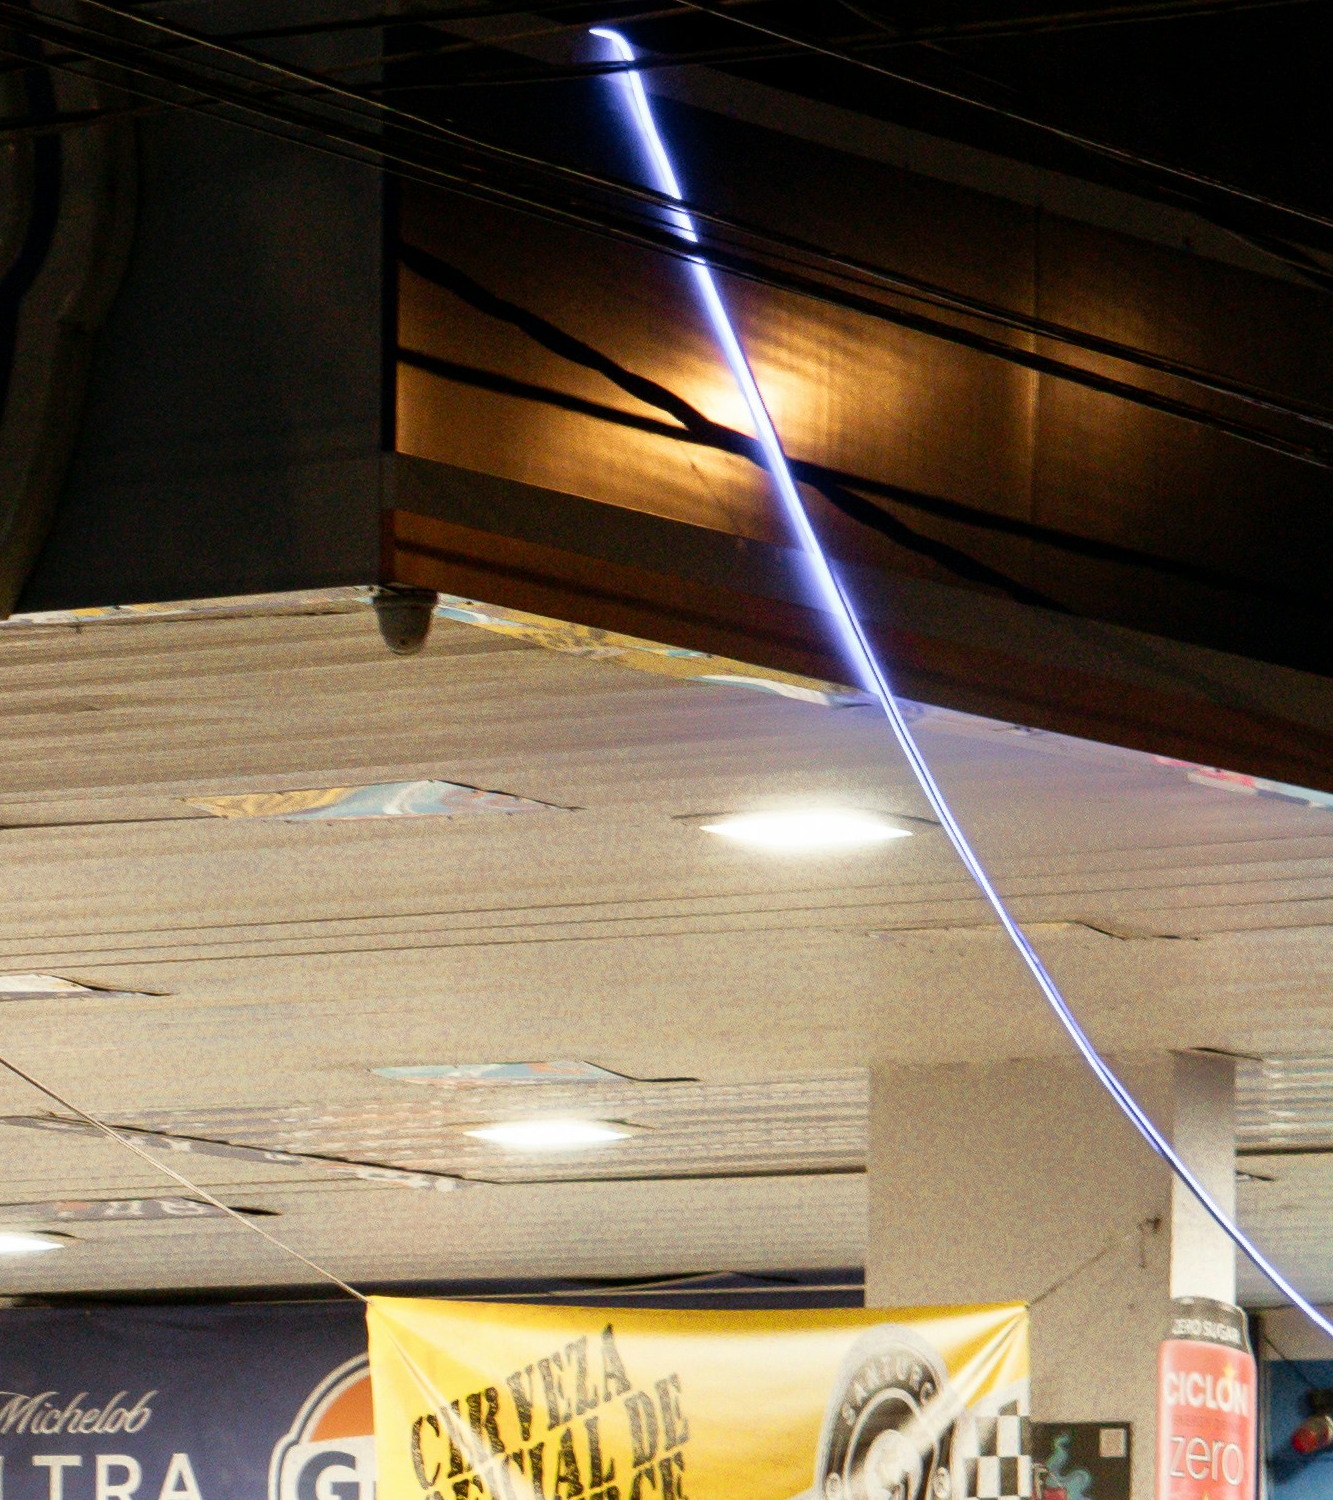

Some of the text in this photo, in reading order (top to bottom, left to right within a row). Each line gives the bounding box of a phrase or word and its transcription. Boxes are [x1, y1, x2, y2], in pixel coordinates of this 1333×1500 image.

[410, 1322, 631, 1490] CERVEZA
[624, 1373, 690, 1469] DE
[1170, 1435, 1244, 1486] zero
